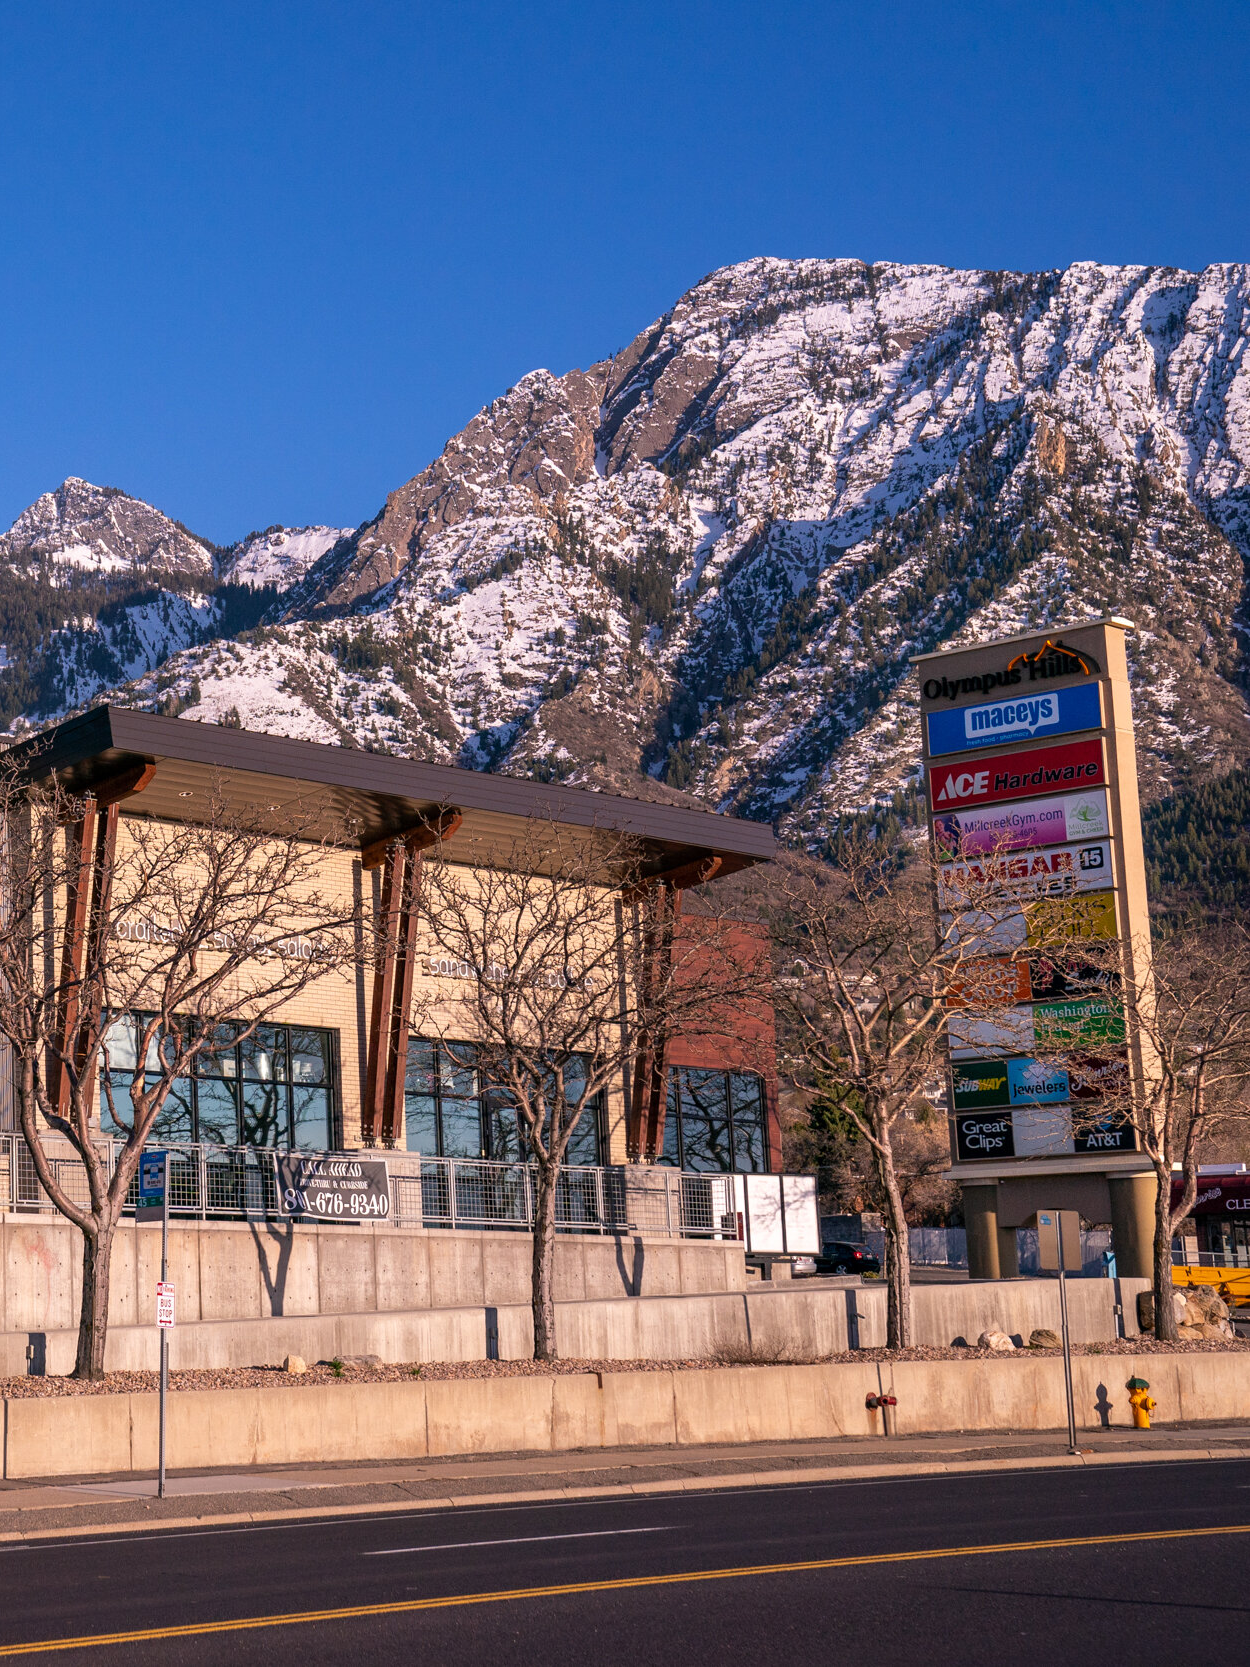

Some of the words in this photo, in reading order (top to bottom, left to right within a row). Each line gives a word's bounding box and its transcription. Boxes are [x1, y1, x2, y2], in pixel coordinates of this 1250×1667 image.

[923, 667, 1021, 700] Olympus
[1022, 653, 1083, 681] Hills
[971, 698, 1053, 731] maceys
[937, 770, 990, 801] ACE
[994, 761, 1099, 792] Hardware
[964, 809, 1063, 833] MillcreekGym.com
[1040, 1003, 1111, 1018] Washington
[955, 1077, 1007, 1093] SUBWAY
[962, 1120, 1008, 1135] Great
[965, 1134, 1005, 1152] Clips
[1086, 1132, 1123, 1147] AT&T
[300, 1160, 327, 1176] CALL
[328, 1162, 362, 1177] AHEAD
[284, 1188, 389, 1215] 801-676-9340
[160, 1298, 171, 1308] BUS
[158, 1308, 172, 1318] STOP
